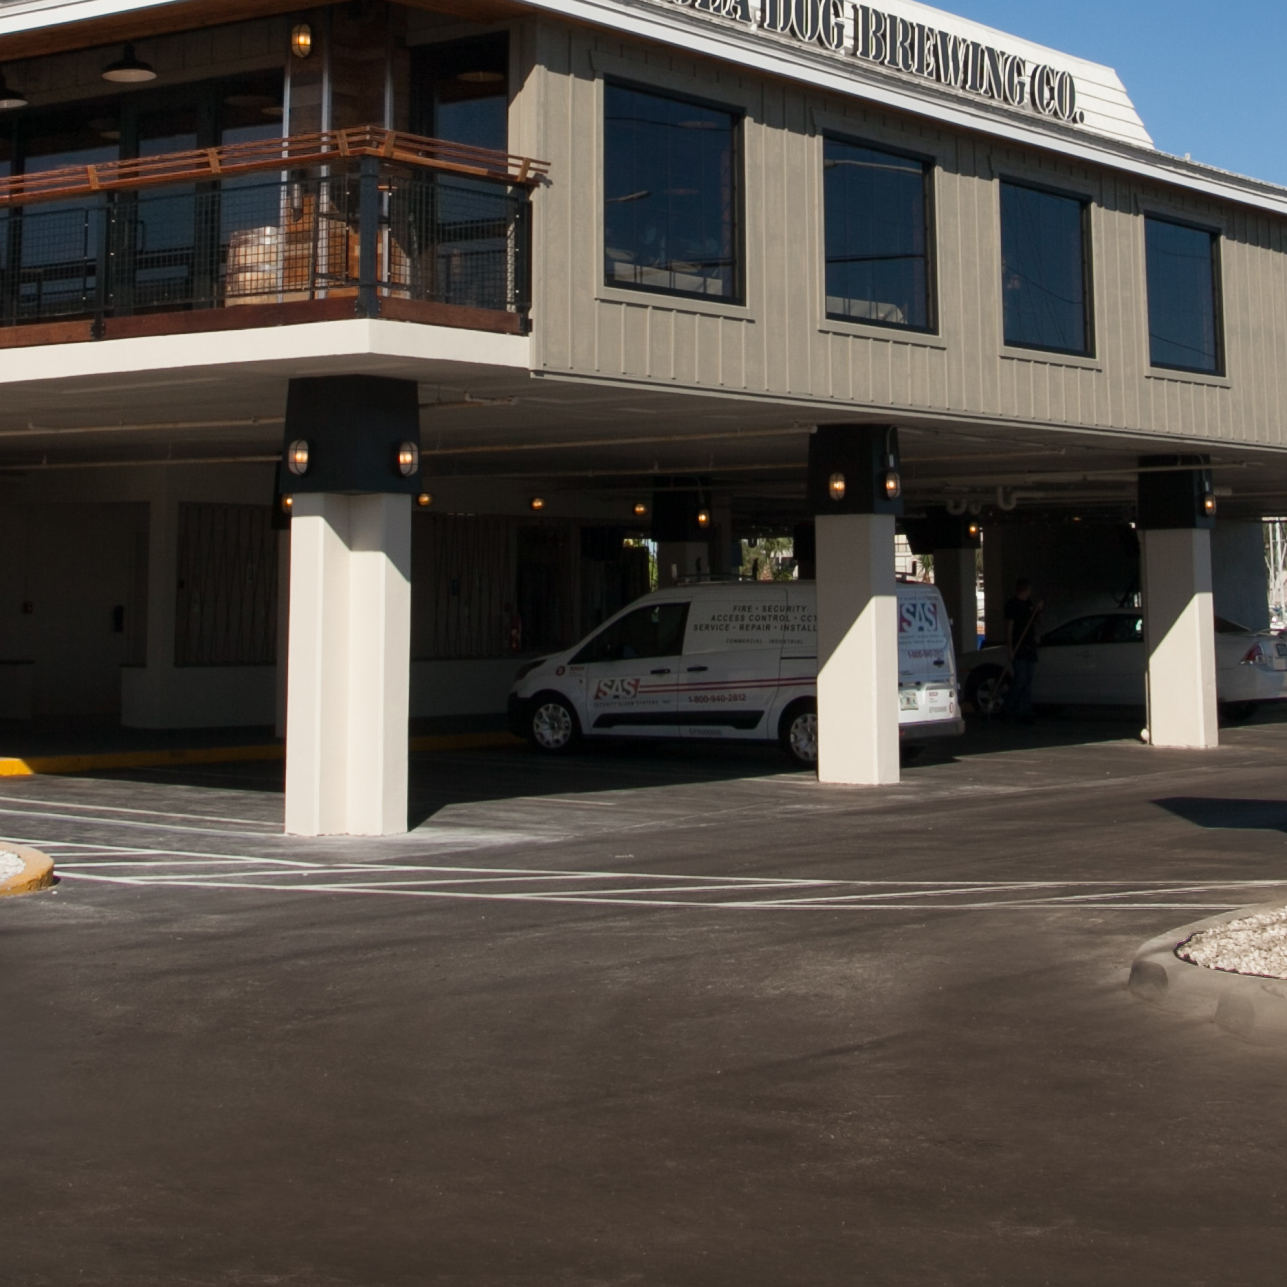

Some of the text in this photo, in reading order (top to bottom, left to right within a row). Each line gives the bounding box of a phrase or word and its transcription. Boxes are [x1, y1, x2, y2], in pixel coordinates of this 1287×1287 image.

[851, 1, 1028, 107] BREWING
[1030, 63, 1085, 125] CO.
[732, 605, 808, 613] FIRE SECURITY
[710, 614, 745, 622] ACCESS
[748, 614, 791, 622] CONTROL
[900, 602, 937, 633] SAS
[693, 624, 730, 632] SERVICE
[739, 624, 771, 632] REPAIR
[594, 678, 641, 700] SAS
[688, 693, 747, 703] 1-800-940-2812
